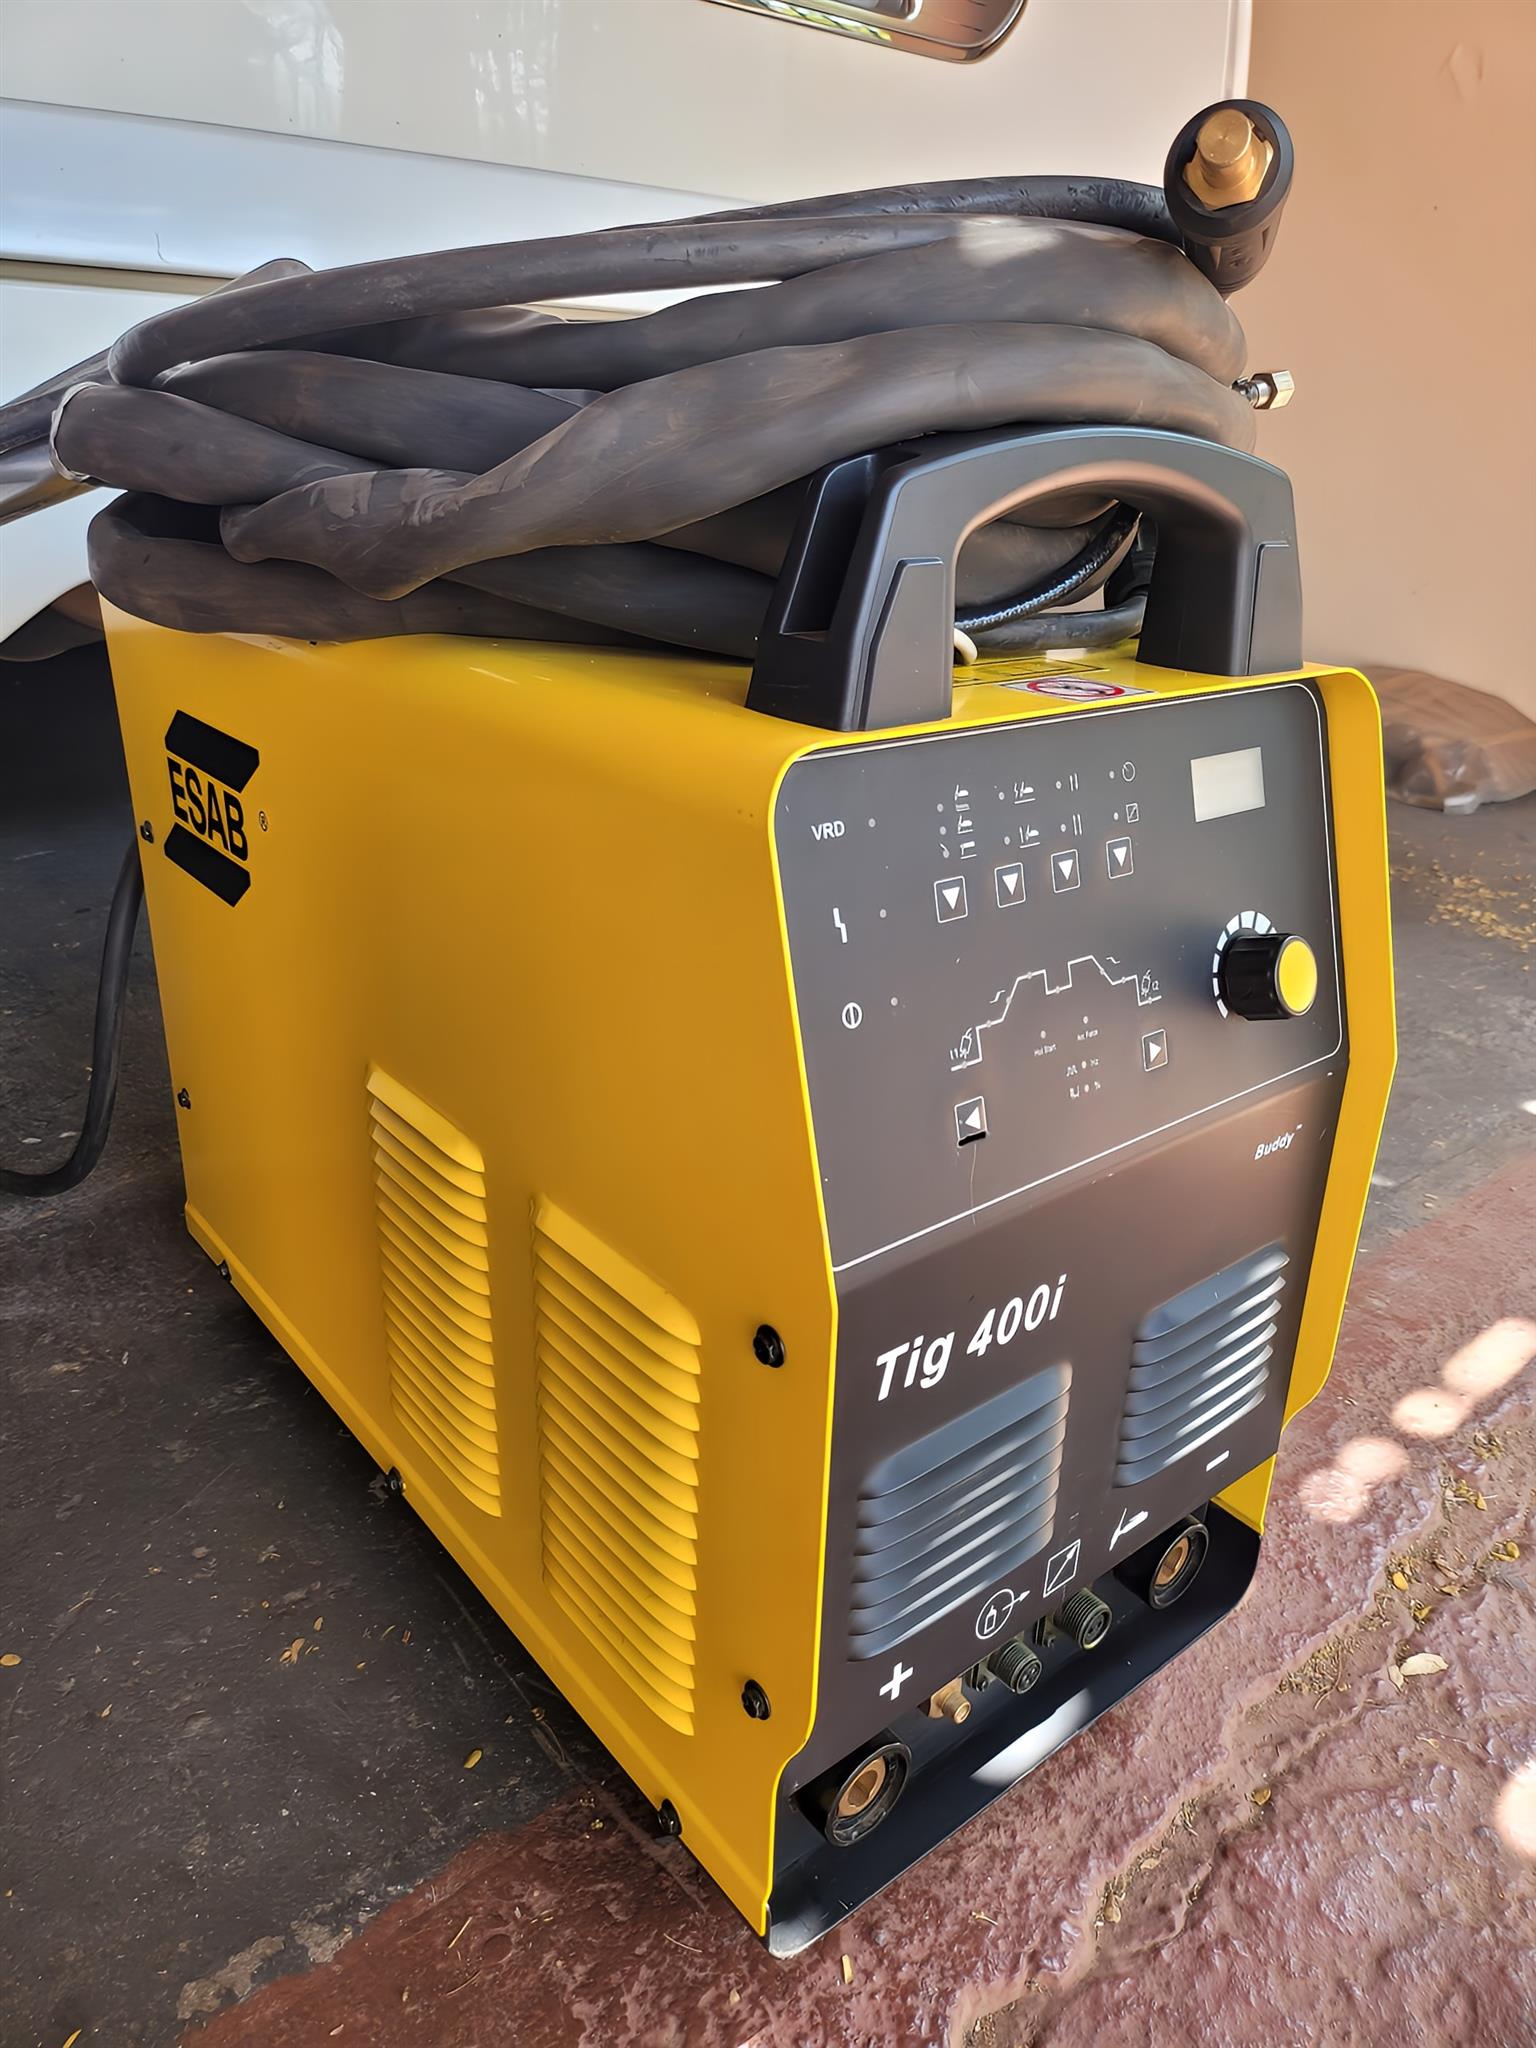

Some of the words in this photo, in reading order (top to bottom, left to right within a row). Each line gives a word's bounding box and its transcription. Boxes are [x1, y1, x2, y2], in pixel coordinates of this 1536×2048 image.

[167, 756, 249, 861] ESAB
[811, 820, 846, 841] VRD
[876, 1331, 955, 1402] Tig
[966, 1273, 1067, 1357] 400i
